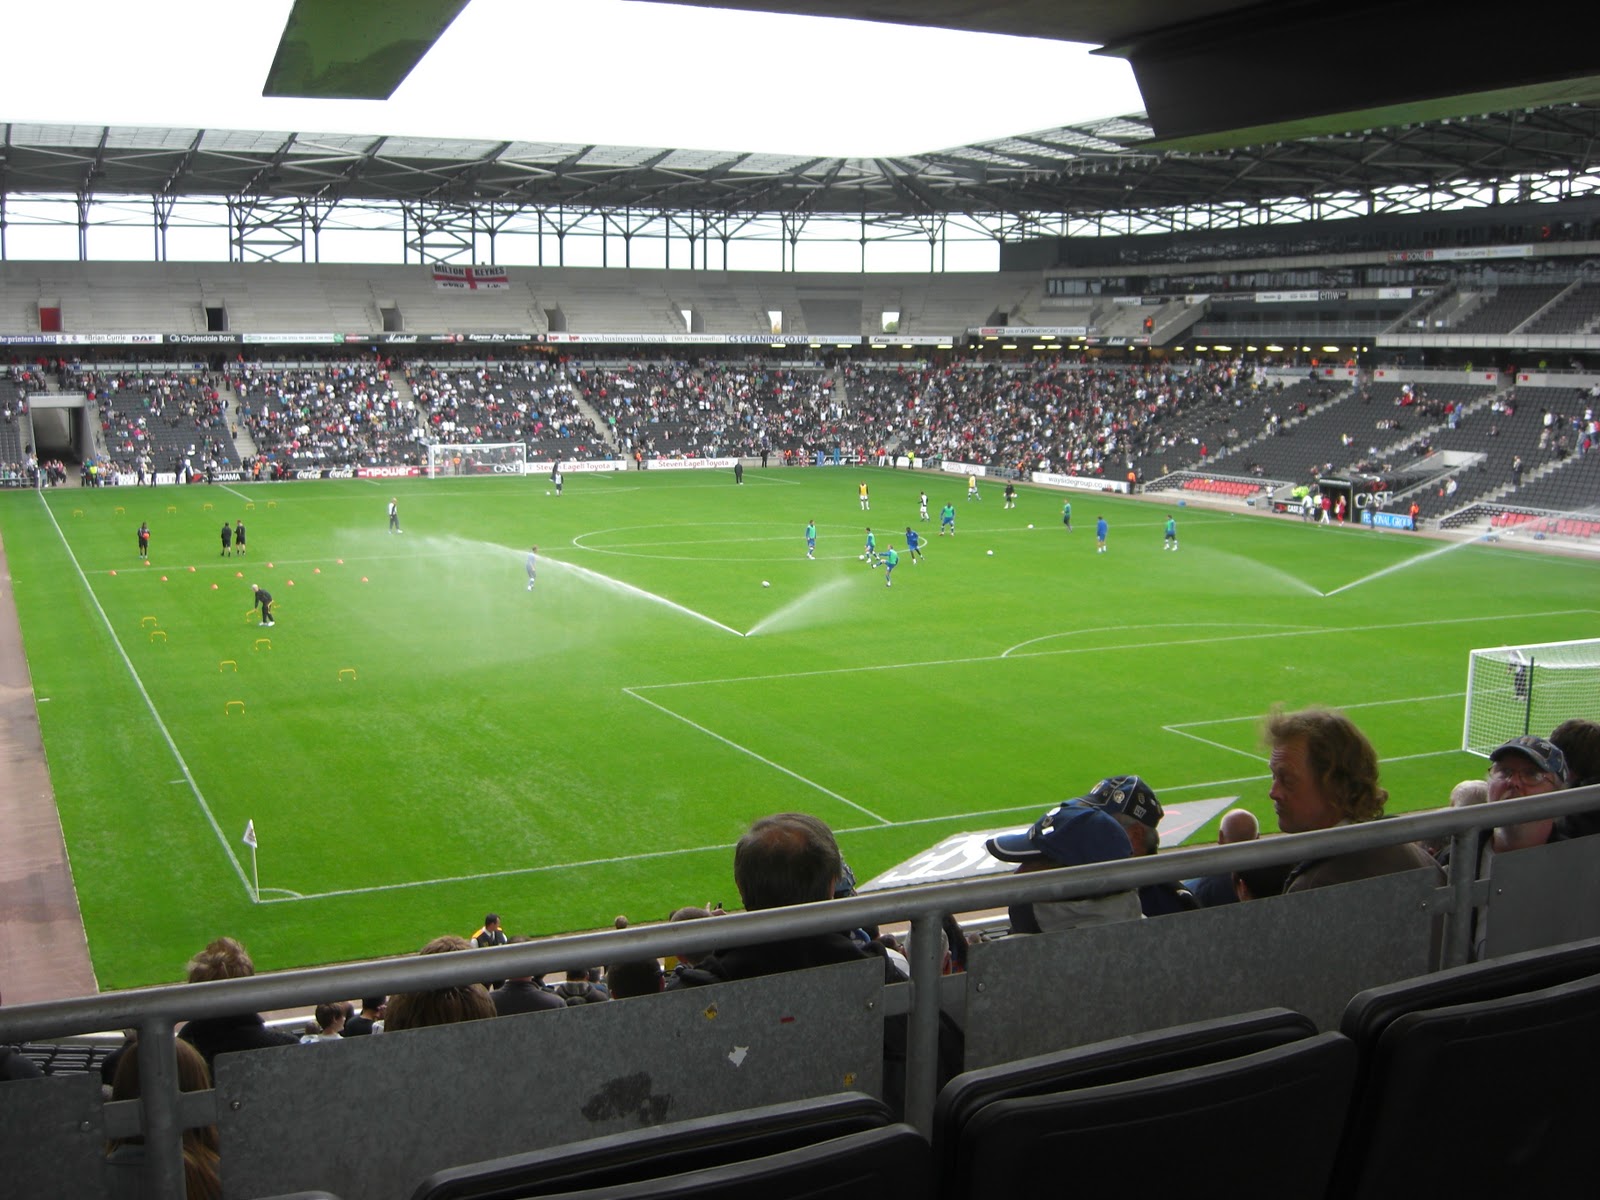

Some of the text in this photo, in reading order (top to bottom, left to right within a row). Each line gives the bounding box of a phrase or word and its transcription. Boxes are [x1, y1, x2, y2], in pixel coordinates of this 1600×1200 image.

[434, 264, 505, 276] MILTON KEYNES
[181, 335, 218, 343] Clydesdale
[563, 462, 585, 472] Eagell
[587, 461, 611, 471] Toyota
[684, 459, 705, 469] Eagell
[706, 459, 729, 468] Toyota
[366, 467, 413, 477] npower
[493, 465, 520, 474] CASE
[1354, 491, 1393, 509] CASE
